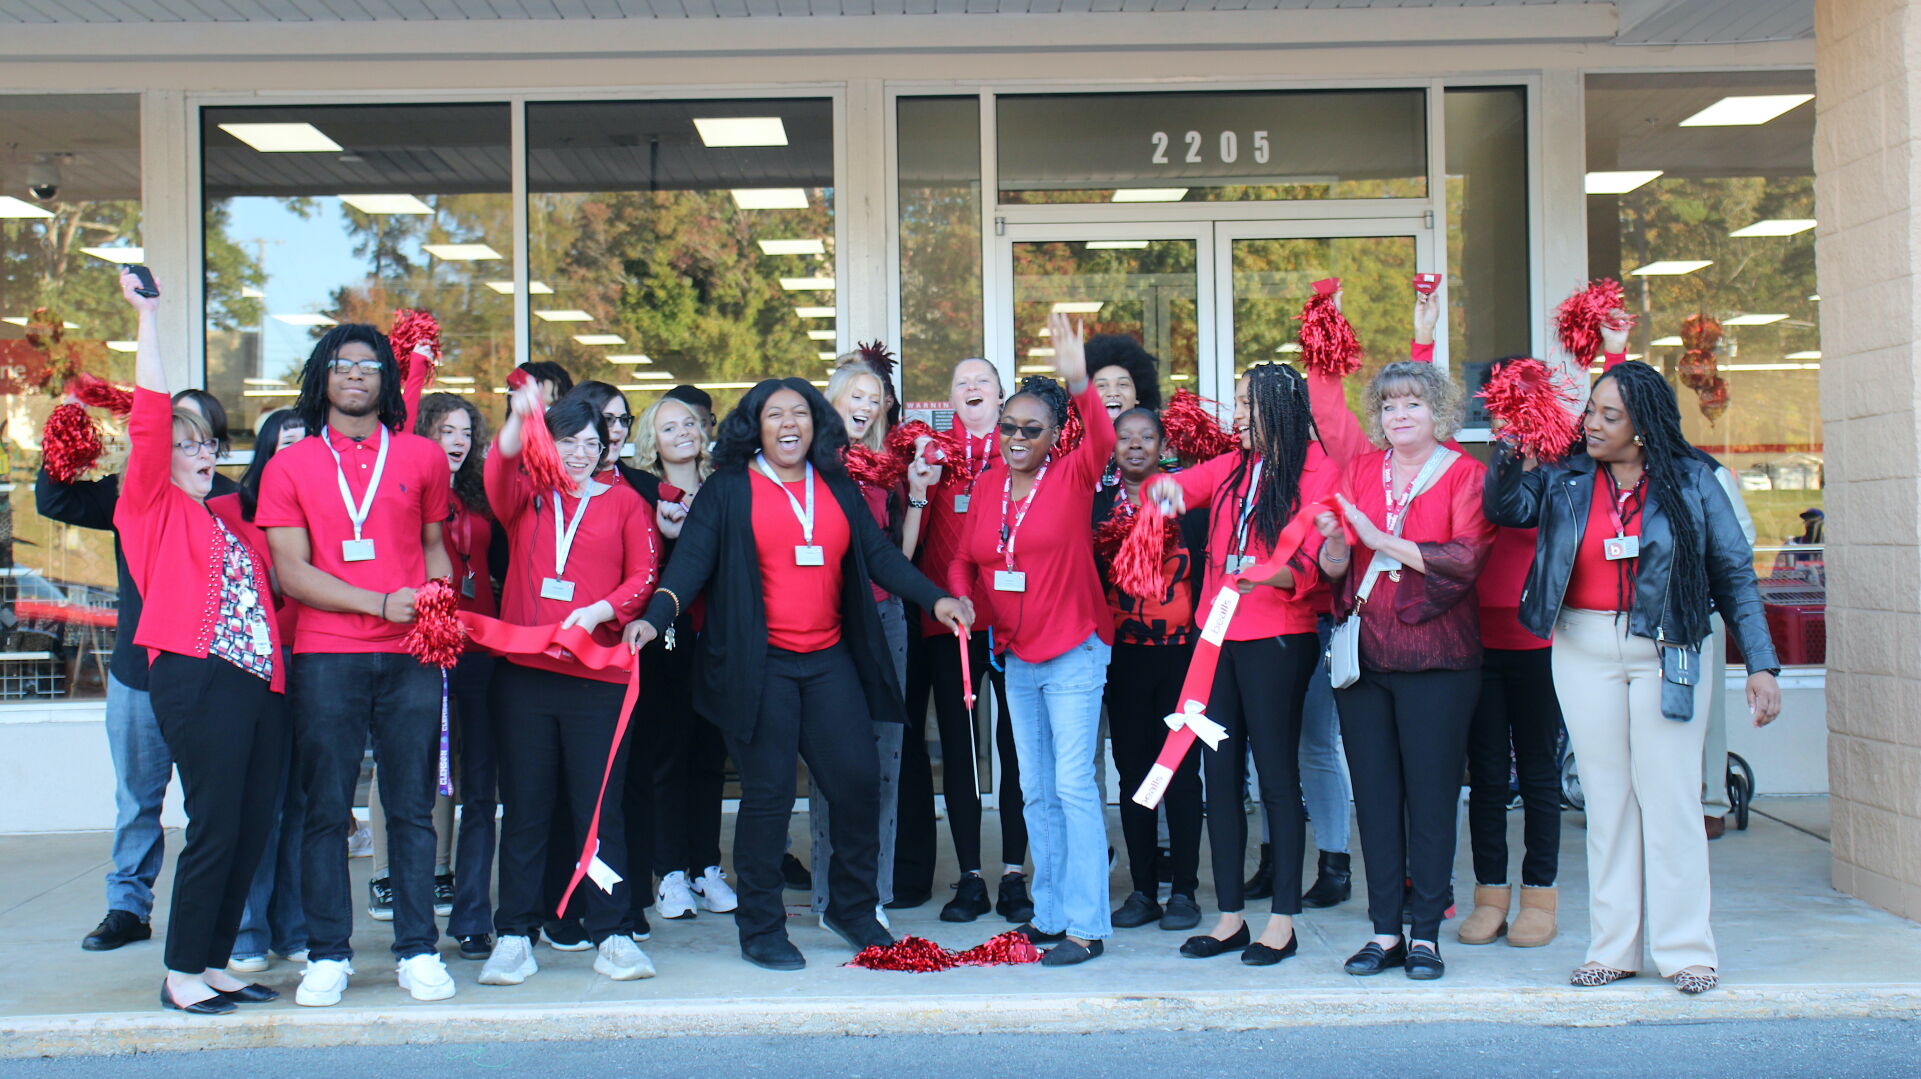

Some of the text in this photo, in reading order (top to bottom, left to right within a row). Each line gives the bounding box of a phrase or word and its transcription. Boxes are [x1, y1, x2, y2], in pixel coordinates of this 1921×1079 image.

[1151, 130, 1270, 164] 2205
[906, 401, 950, 409] WARNIN
[1210, 599, 1232, 635] bealls
